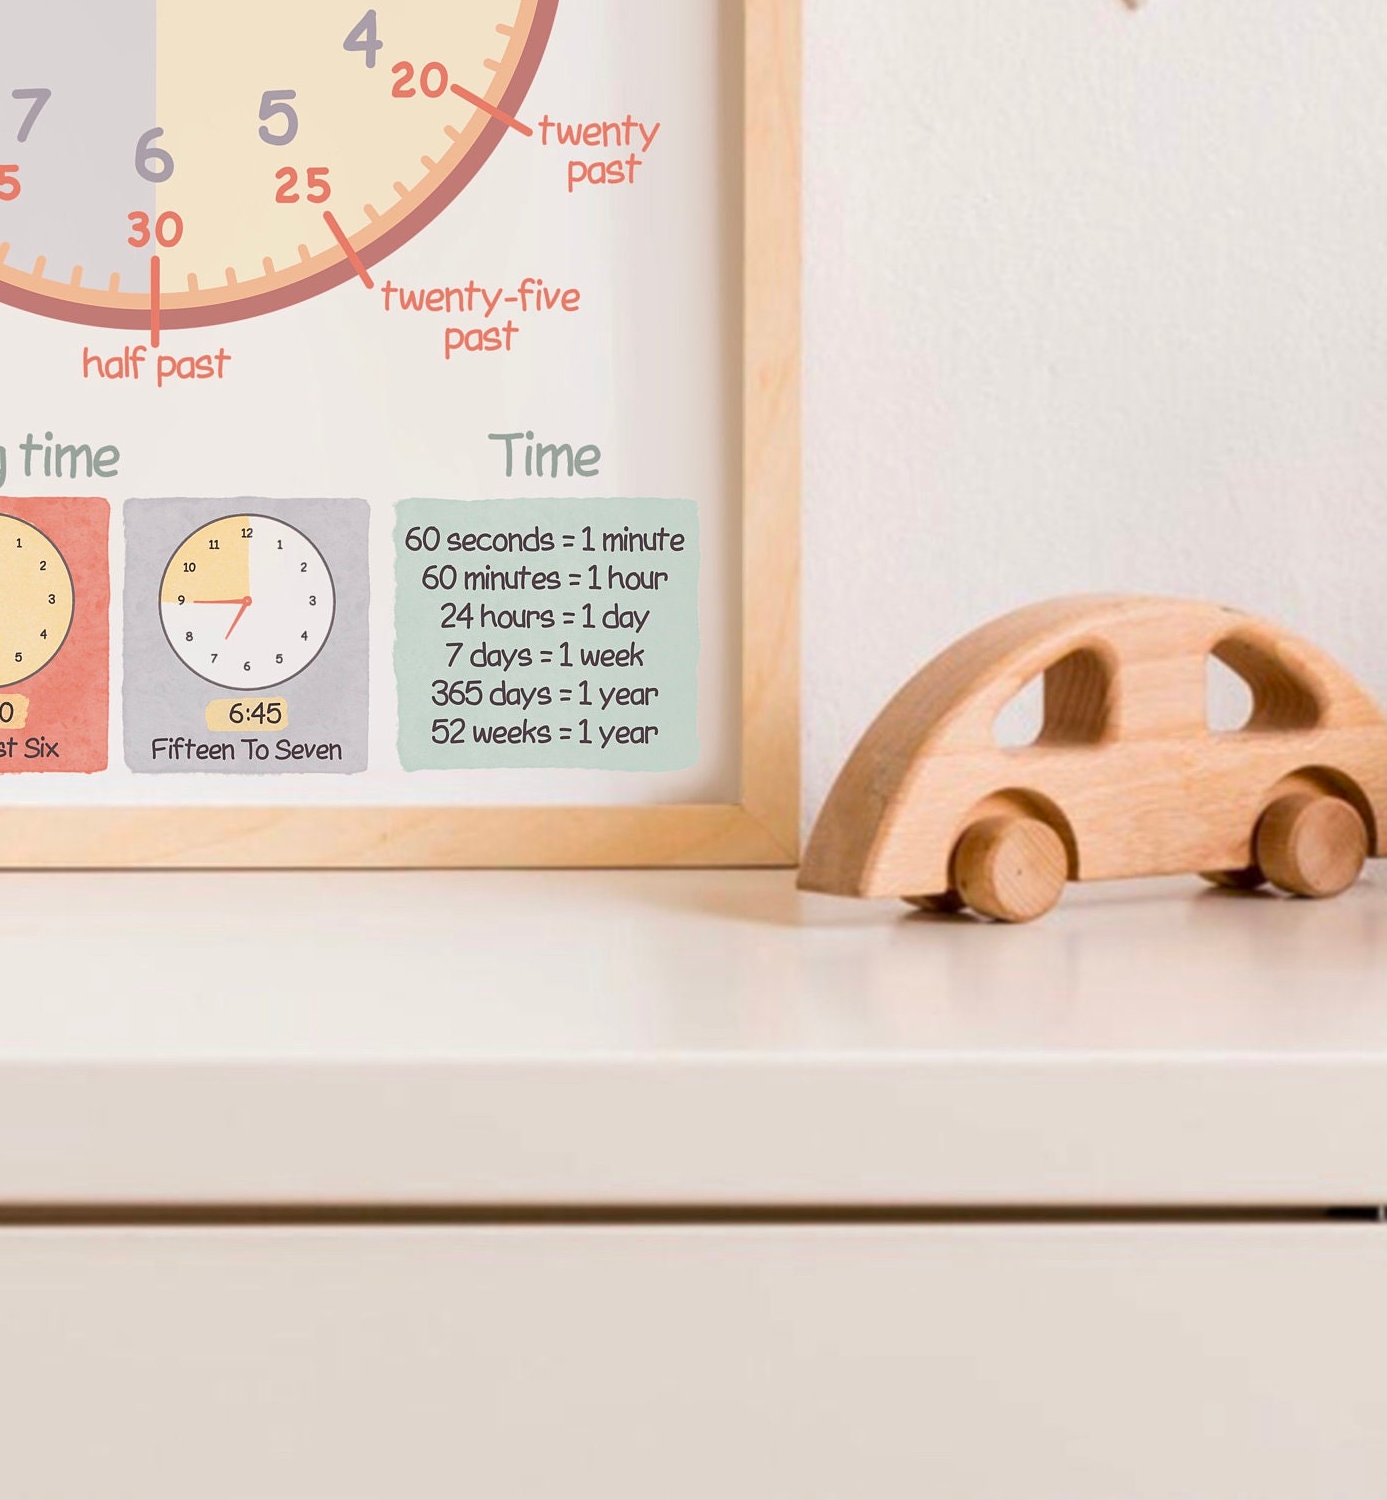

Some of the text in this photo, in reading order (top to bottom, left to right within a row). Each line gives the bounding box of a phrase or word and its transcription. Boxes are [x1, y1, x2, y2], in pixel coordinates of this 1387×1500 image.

[343, 9, 383, 68] 4
[392, 61, 448, 98] 20
[12, 88, 51, 142] 7
[259, 90, 298, 146] 5
[538, 115, 660, 152] twenty
[135, 127, 174, 182] 6
[568, 153, 642, 192] past
[276, 167, 331, 203] 25
[128, 211, 183, 247] 30
[381, 278, 580, 318] twenty-five
[445, 320, 519, 360] past
[83, 345, 231, 387] half past
[19, 431, 120, 478] time
[488, 431, 601, 478] Time
[17, 538, 22, 548] 1
[209, 540, 219, 549] 11
[241, 528, 253, 538] 12
[277, 540, 283, 549] 1
[405, 526, 440, 551] 60
[447, 526, 555, 552] seconds
[582, 526, 595, 551] 1
[603, 526, 684, 552] minute
[40, 561, 46, 570] 2
[184, 562, 196, 572] 10
[301, 562, 307, 572] 2
[422, 565, 457, 590] 60
[465, 565, 561, 591] minutes
[589, 565, 601, 590] 1
[608, 565, 668, 590] hour
[49, 594, 55, 604] 3
[178, 595, 185, 605] 9
[309, 596, 316, 606] 3
[441, 603, 474, 629] 24
[481, 604, 555, 629] hours
[582, 603, 595, 628] 1
[602, 603, 650, 633] day
[40, 629, 47, 639] 4
[186, 631, 193, 641] 8
[301, 631, 308, 641] 4
[15, 652, 22, 662] 5
[211, 654, 218, 663] 7
[244, 661, 250, 671] 6
[276, 654, 283, 664] 5
[446, 643, 463, 667] 7
[470, 642, 532, 672] days
[560, 642, 573, 667] 1
[581, 641, 644, 667] week
[432, 680, 482, 706] 365
[490, 680, 552, 710] days
[579, 680, 592, 705] 1
[599, 687, 658, 710] year
[229, 702, 281, 724] 6:45
[432, 718, 465, 744] 52
[473, 719, 552, 744] weeks
[579, 719, 592, 744] 1
[599, 726, 658, 749] year
[24, 736, 59, 758] Six
[152, 737, 342, 760] Fifteen To Seven
